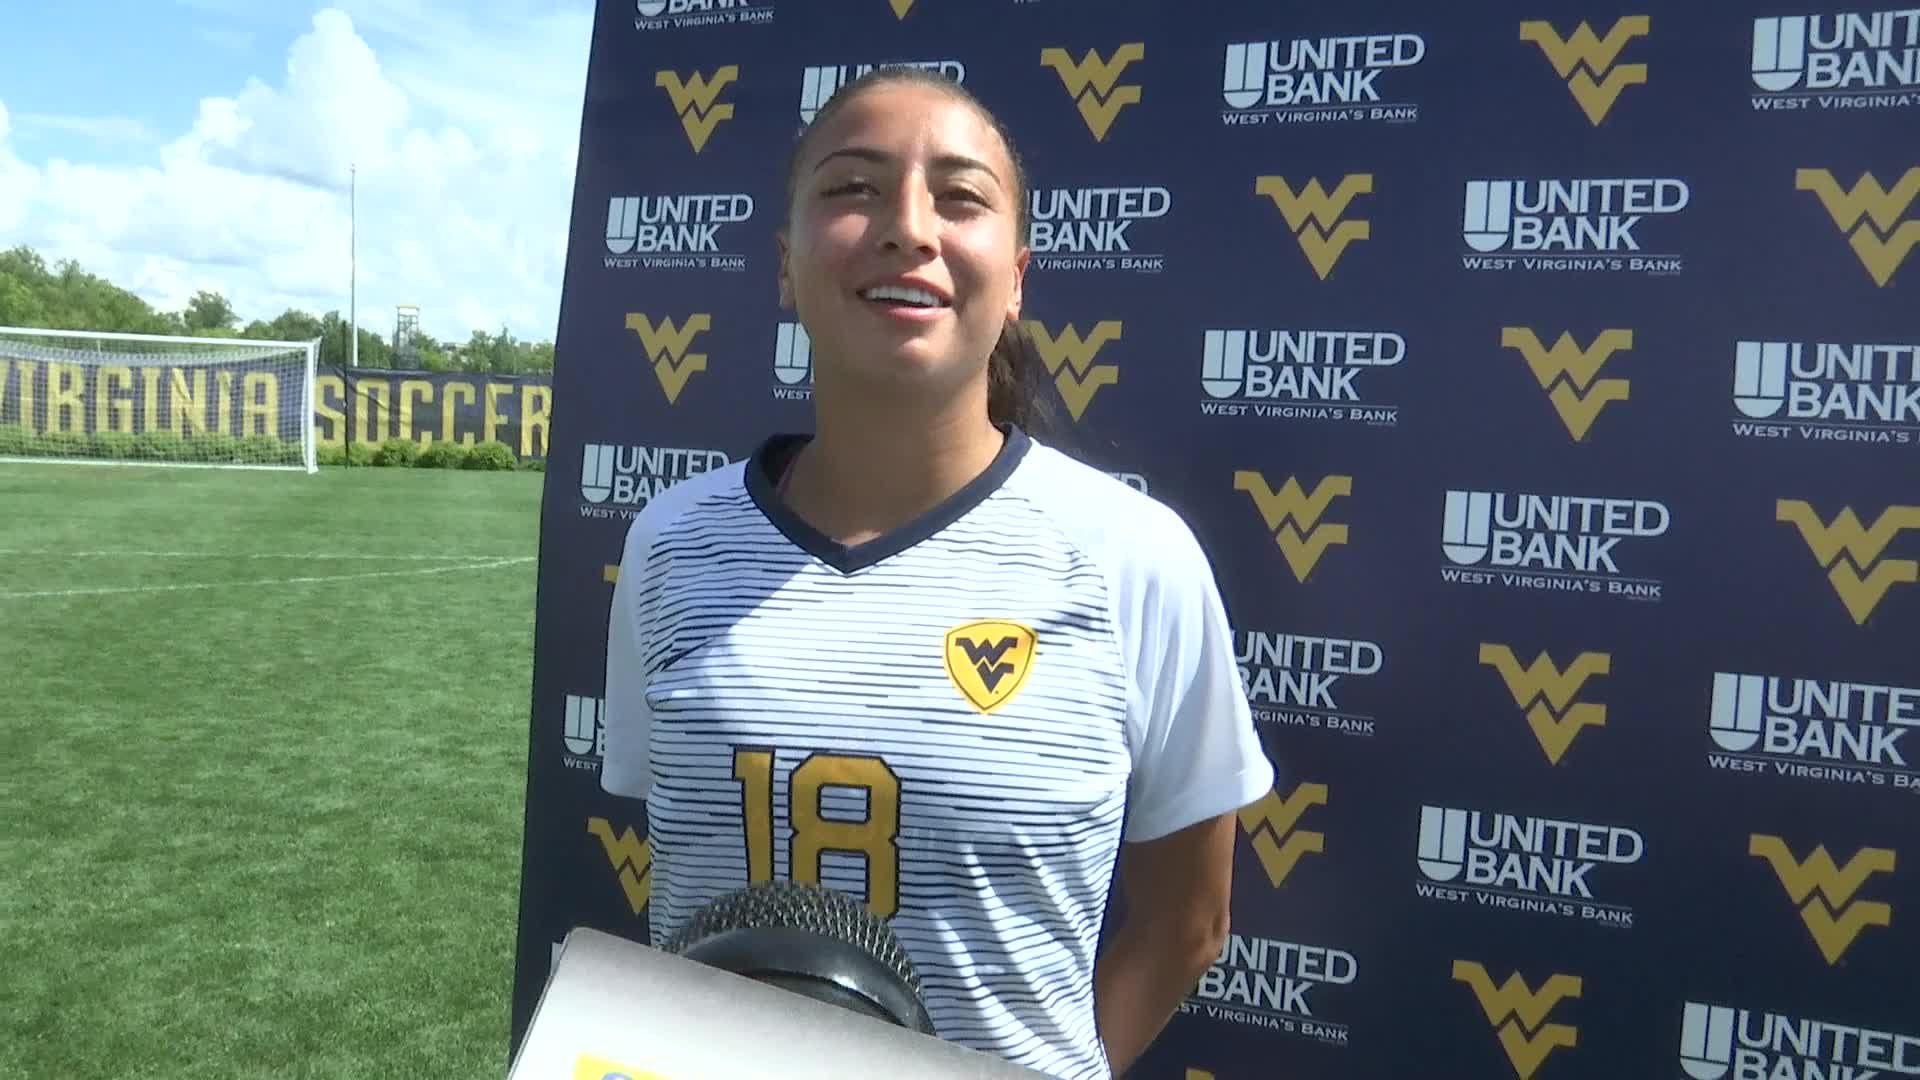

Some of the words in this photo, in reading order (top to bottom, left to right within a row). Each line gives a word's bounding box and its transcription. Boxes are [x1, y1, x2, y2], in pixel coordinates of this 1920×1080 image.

[634, 20, 669, 31] WEST
[674, 14, 736, 28] VIRGINIA'S
[740, 11, 774, 23] BANK
[1270, 33, 1426, 73] UNITED
[1806, 49, 1920, 89] BAN
[1266, 69, 1383, 105] BANK
[1752, 97, 1811, 110] WEST
[1222, 113, 1269, 125] WEST
[1275, 110, 1364, 123] VIRGINIA'S
[1370, 108, 1417, 120] BANK
[641, 194, 754, 223] UNITED
[1031, 187, 1171, 220] UNITED
[1515, 178, 1690, 214] UNITED
[637, 224, 721, 252] BANK
[1029, 220, 1132, 252] BANK
[1512, 215, 1641, 250] BANK
[604, 257, 637, 268] WEST
[643, 257, 706, 268] VIRGINIA'S
[711, 257, 746, 268] BANK
[1037, 257, 1115, 270] VIRGINIA'S
[1121, 258, 1164, 270] BANK
[1463, 257, 1516, 270] WEST
[1522, 257, 1622, 271] VIRGINIA'S
[1630, 258, 1682, 271] BANK
[1249, 330, 1406, 366] UNITED
[1791, 342, 1920, 382] UNIT
[773, 387, 811, 400] WEST
[1245, 365, 1363, 401] BANK
[0, 358, 279, 440] IRGINIA
[313, 375, 552, 457] SOCCER
[1200, 402, 1248, 416] WEST
[1254, 404, 1343, 420] VIRGINIA'S
[1350, 408, 1397, 422] BANK
[1787, 381, 1920, 422] BANK
[1733, 423, 1791, 438] WEST
[1800, 426, 1909, 443] VIRGINIA'S
[1494, 492, 1670, 536] UNITED
[1490, 529, 1621, 574] BANK
[1441, 569, 1494, 585] WEST
[1501, 573, 1600, 592] VIRGINIA'S
[1608, 582, 1661, 597] BANK
[1233, 630, 1383, 675] UNITED
[1250, 708, 1320, 728] RGINIA'S
[1327, 716, 1375, 734] BANK
[1763, 715, 1907, 766] BANK
[1708, 754, 1767, 773] WEST
[1774, 761, 1884, 785] VIRGINIA'S
[732, 746, 901, 920] 18
[1470, 811, 1643, 864] UNITED
[1466, 848, 1596, 899] BANK
[1416, 883, 1470, 902] WEST
[1476, 892, 1574, 917] VIRGINIA'S
[1582, 906, 1633, 924] BANK
[1197, 966, 1312, 1016] BANK
[1206, 1005, 1294, 1032] VIRGINIA'S
[1302, 1023, 1349, 1041] BANK
[1737, 1009, 1920, 1075] UNITED
